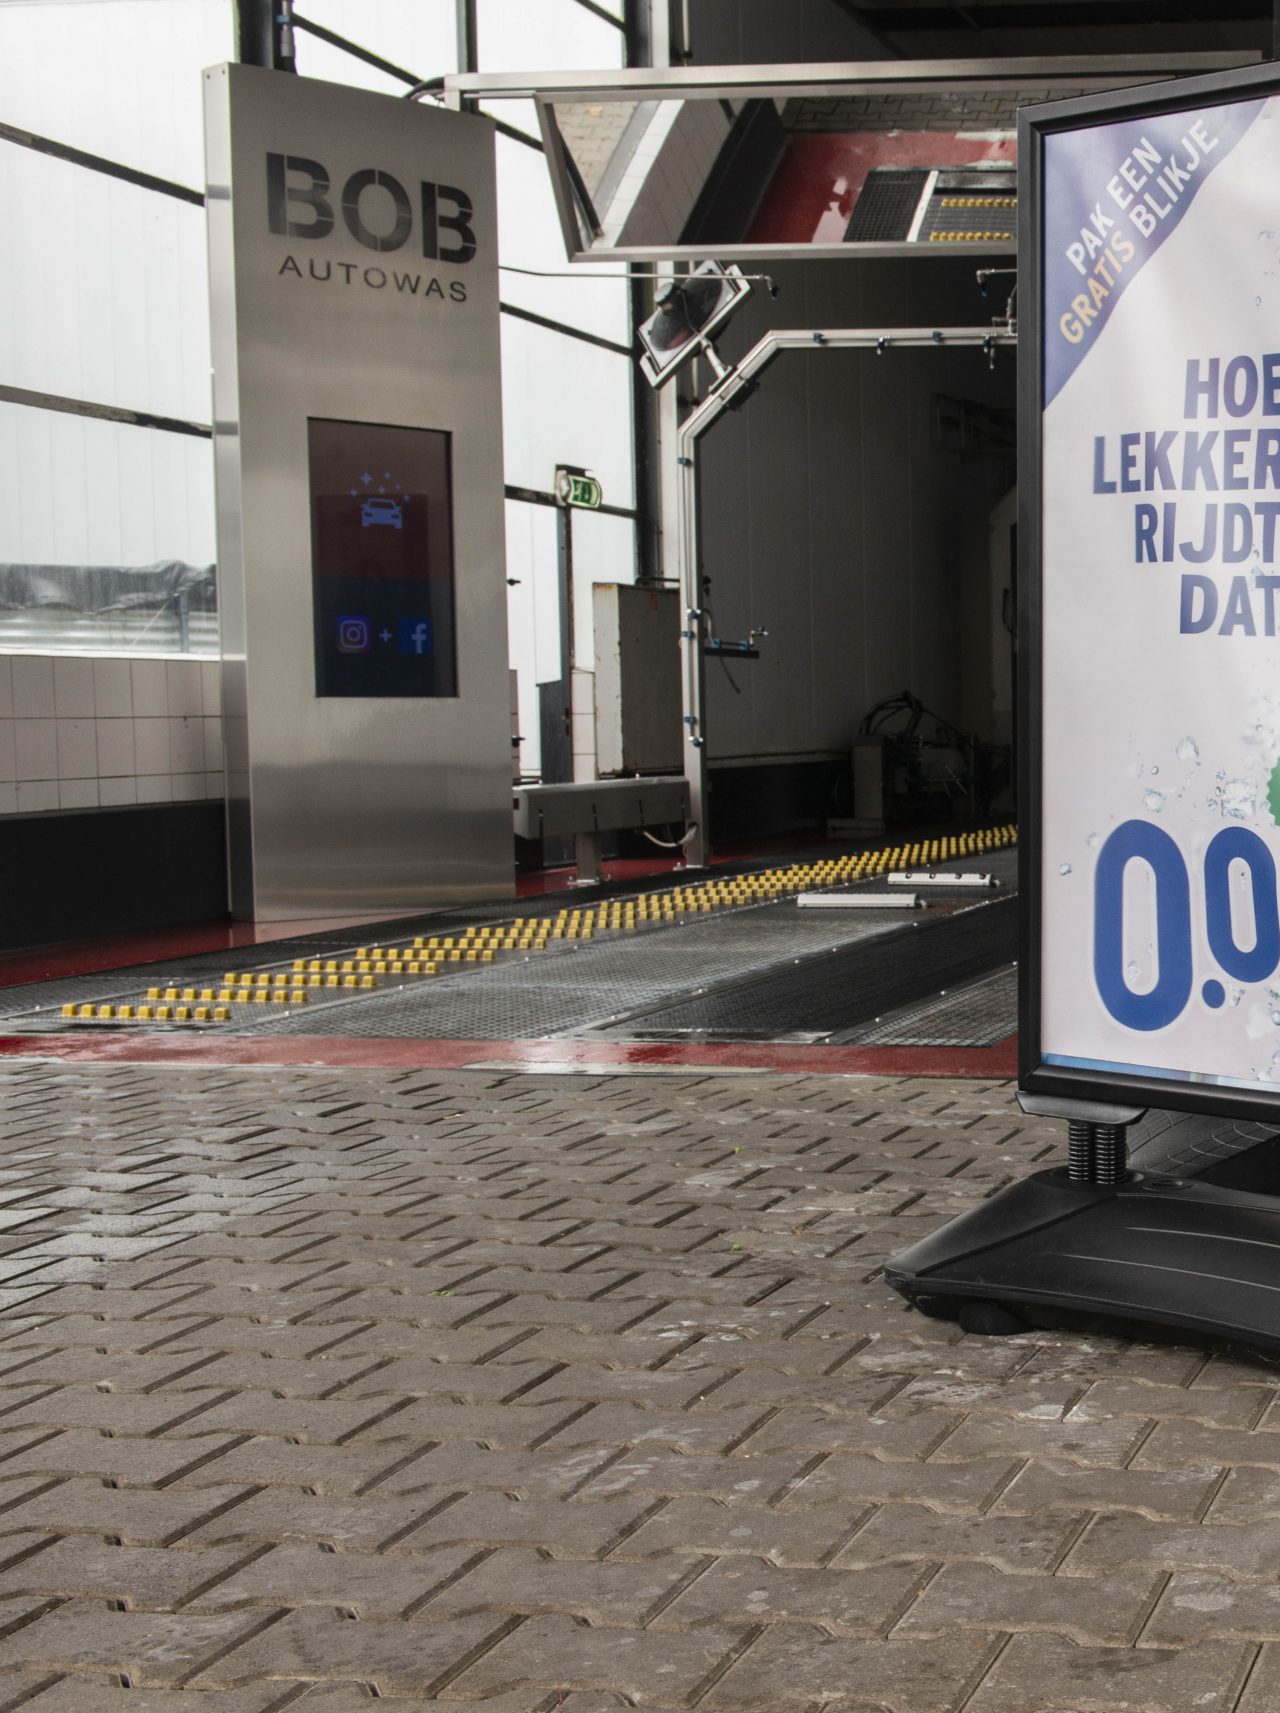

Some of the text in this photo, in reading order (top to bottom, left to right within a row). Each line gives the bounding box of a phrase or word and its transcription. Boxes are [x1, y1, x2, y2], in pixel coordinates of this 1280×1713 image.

[266, 151, 477, 264] BOB
[1059, 118, 1219, 344] GRATIS BLIKJE
[1065, 136, 1163, 275] PAK EEN
[278, 255, 467, 303] AUTOWAS
